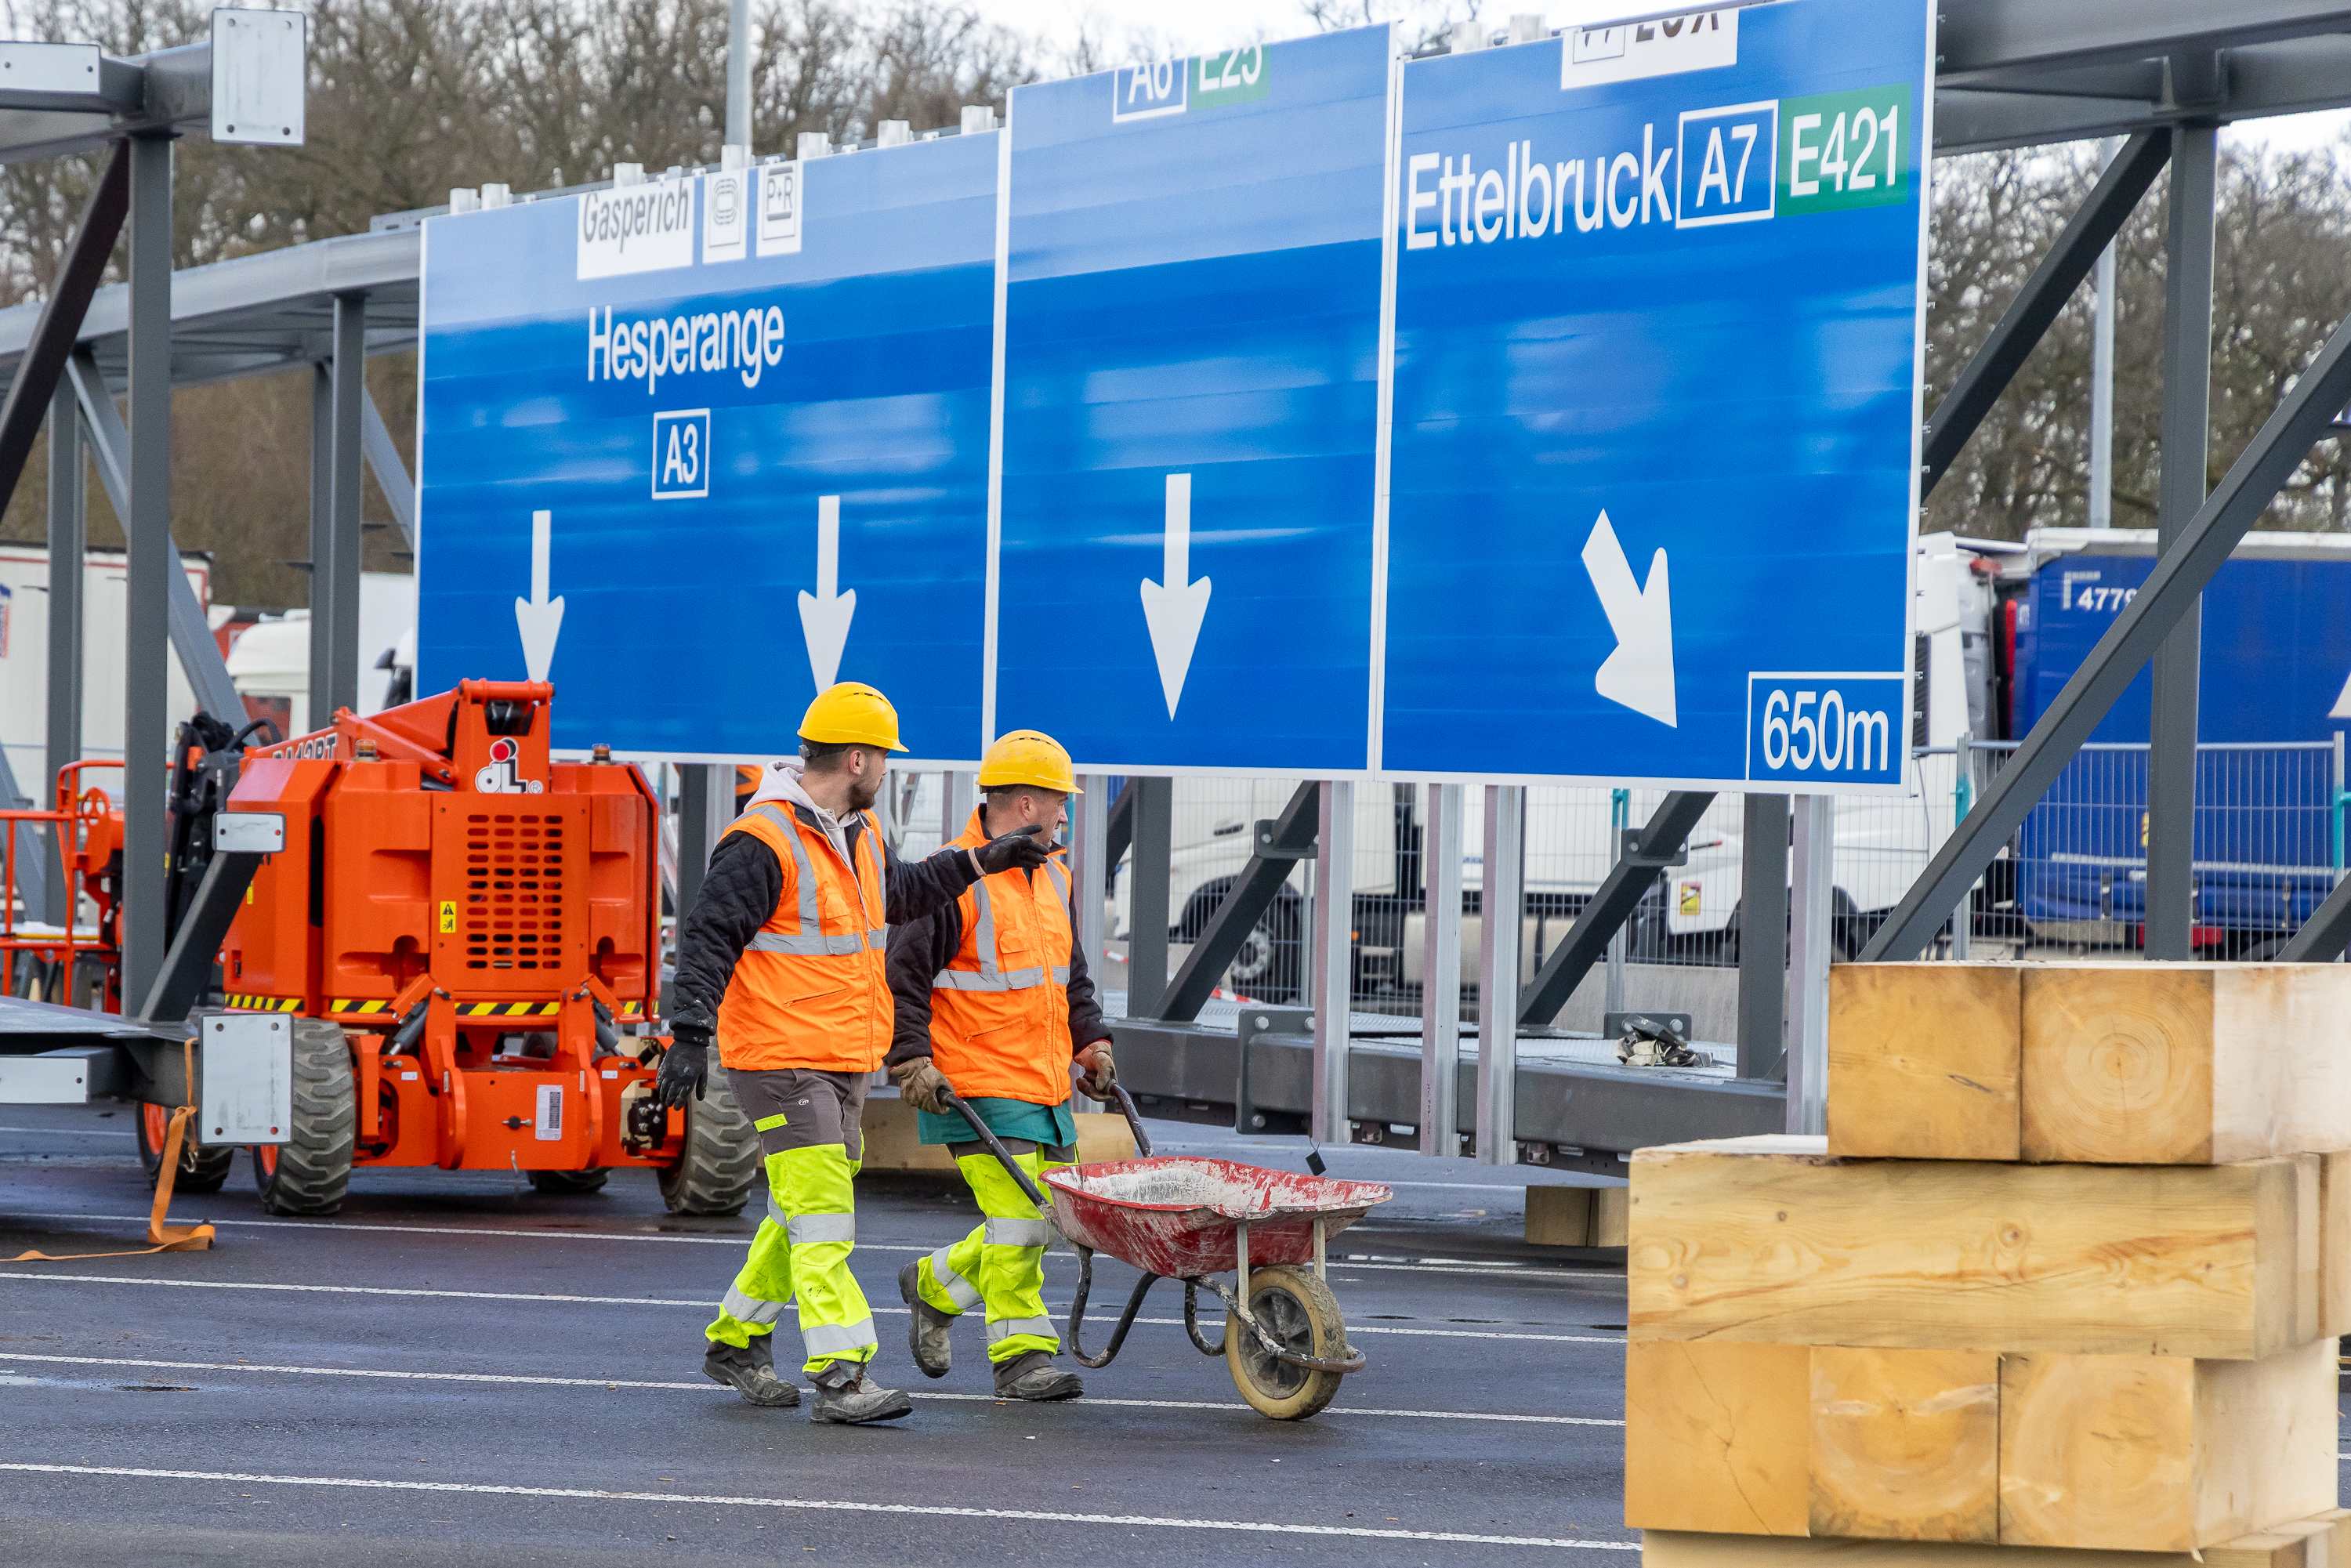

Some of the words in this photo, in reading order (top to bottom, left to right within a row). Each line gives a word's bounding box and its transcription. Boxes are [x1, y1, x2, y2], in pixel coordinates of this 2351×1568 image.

[584, 179, 689, 253] Gasperich
[1407, 123, 1673, 250] Ettelbruck
[1697, 124, 1758, 207] A7
[1790, 104, 1898, 197] E421
[588, 306, 784, 395] Hesperange
[663, 423, 698, 484] A3
[1763, 689, 1889, 771] 650m
